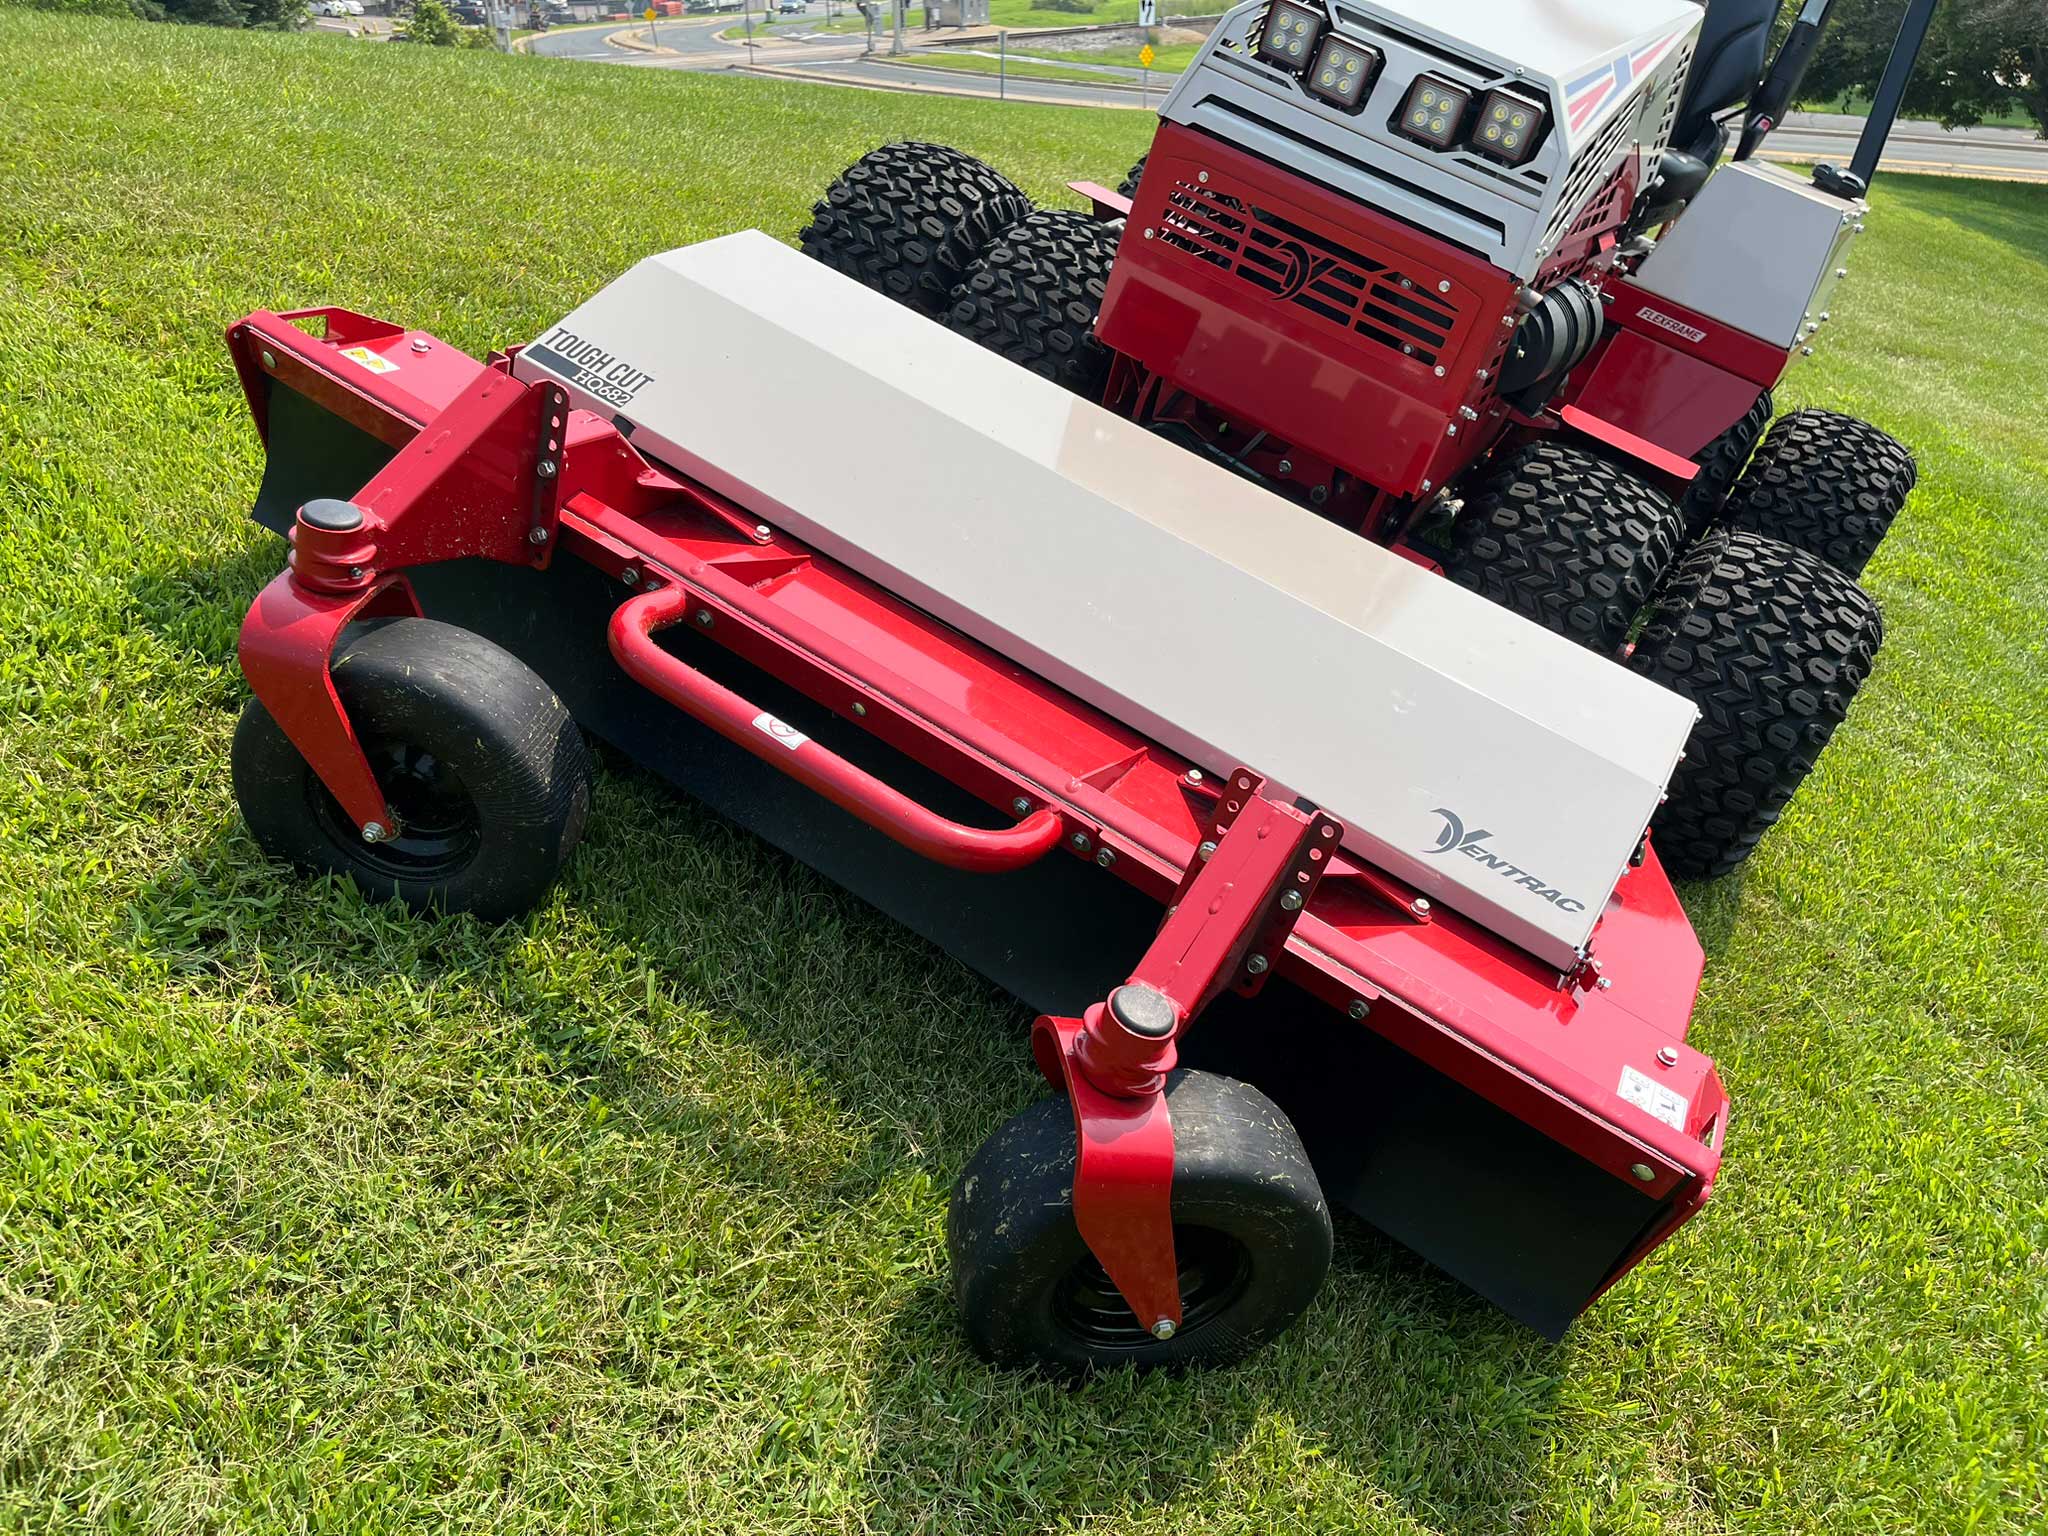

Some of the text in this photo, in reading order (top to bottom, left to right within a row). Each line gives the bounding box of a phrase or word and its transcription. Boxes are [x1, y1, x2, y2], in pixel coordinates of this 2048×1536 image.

[1640, 309, 1702, 340] FLEXFRAME
[545, 327, 655, 394] TOUGH CUT
[571, 369, 633, 406] HQ682
[1421, 807, 1586, 913] VENTRAC
